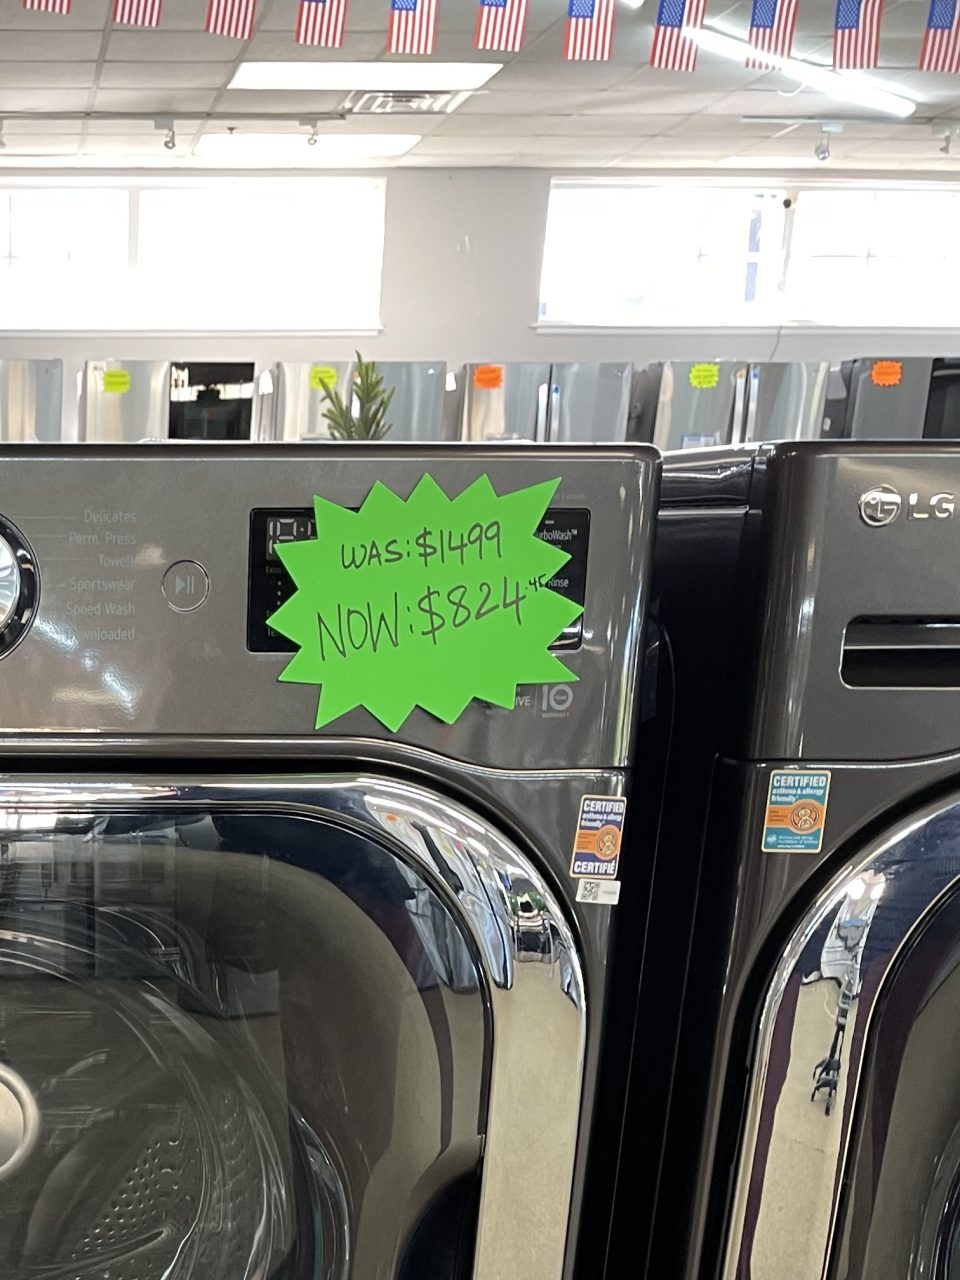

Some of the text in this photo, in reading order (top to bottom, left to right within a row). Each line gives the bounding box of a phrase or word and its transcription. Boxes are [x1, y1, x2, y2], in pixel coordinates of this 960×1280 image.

[907, 491, 955, 520] LG
[83, 508, 137, 523] Delicates
[69, 531, 137, 545] Perm. Press
[98, 554, 137, 568] Towels
[70, 578, 135, 593] Sportswear
[66, 602, 136, 618] Speed Wash
[73, 627, 136, 641] wnloaded
[773, 775, 827, 787] CERTIFIED
[583, 800, 625, 813] CERTIFIED
[573, 860, 616, 874] CERTIFIÉ
